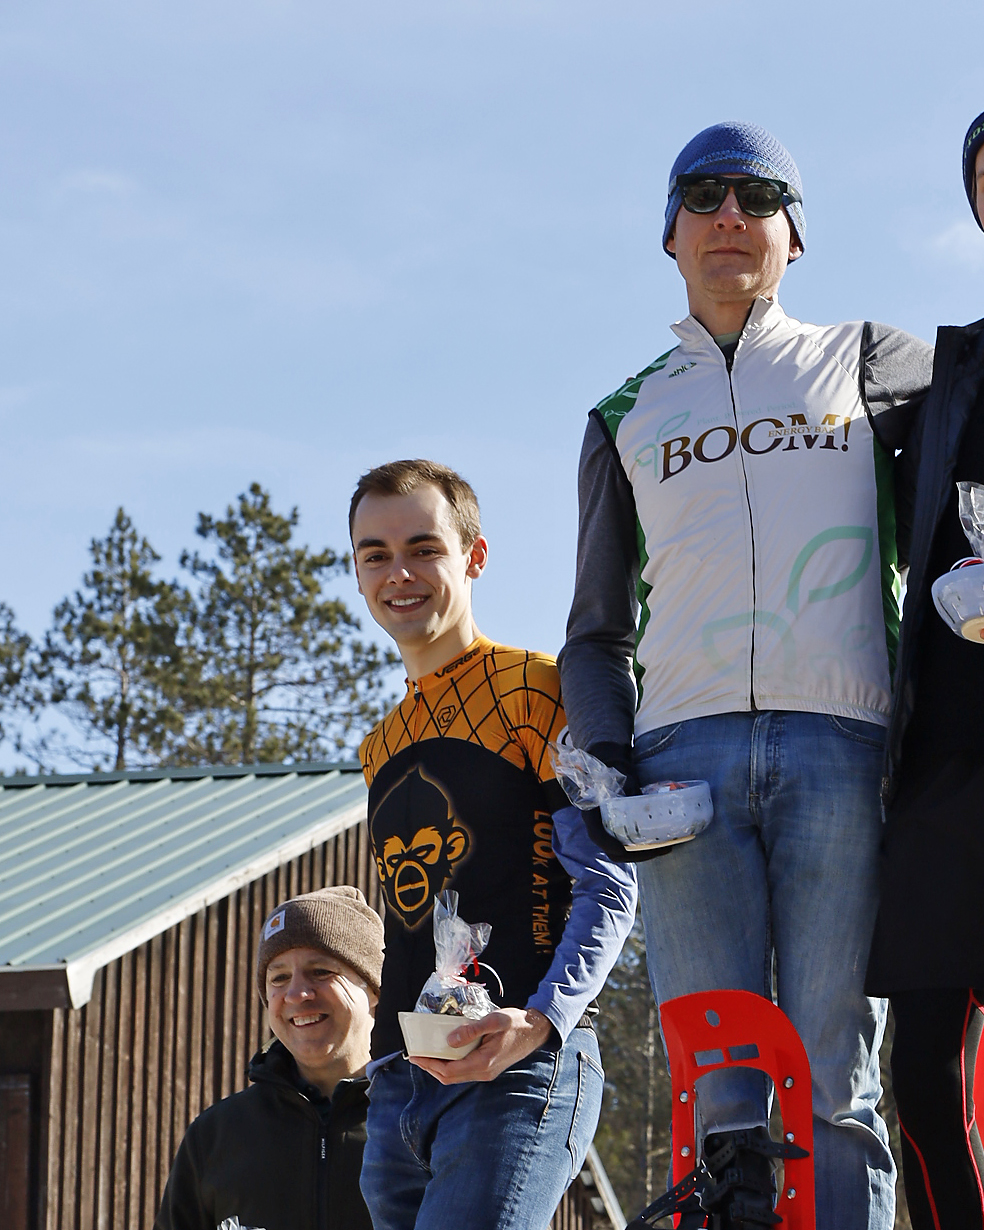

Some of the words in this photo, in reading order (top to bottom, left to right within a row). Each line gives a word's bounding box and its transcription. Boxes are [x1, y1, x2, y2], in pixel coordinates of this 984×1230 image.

[767, 425, 814, 438] ENERGY
[814, 424, 836, 435] BAR
[659, 413, 851, 484] BOOM!
[434, 647, 480, 678] VERGE
[533, 809, 555, 868] LOOK
[532, 873, 548, 899] AT
